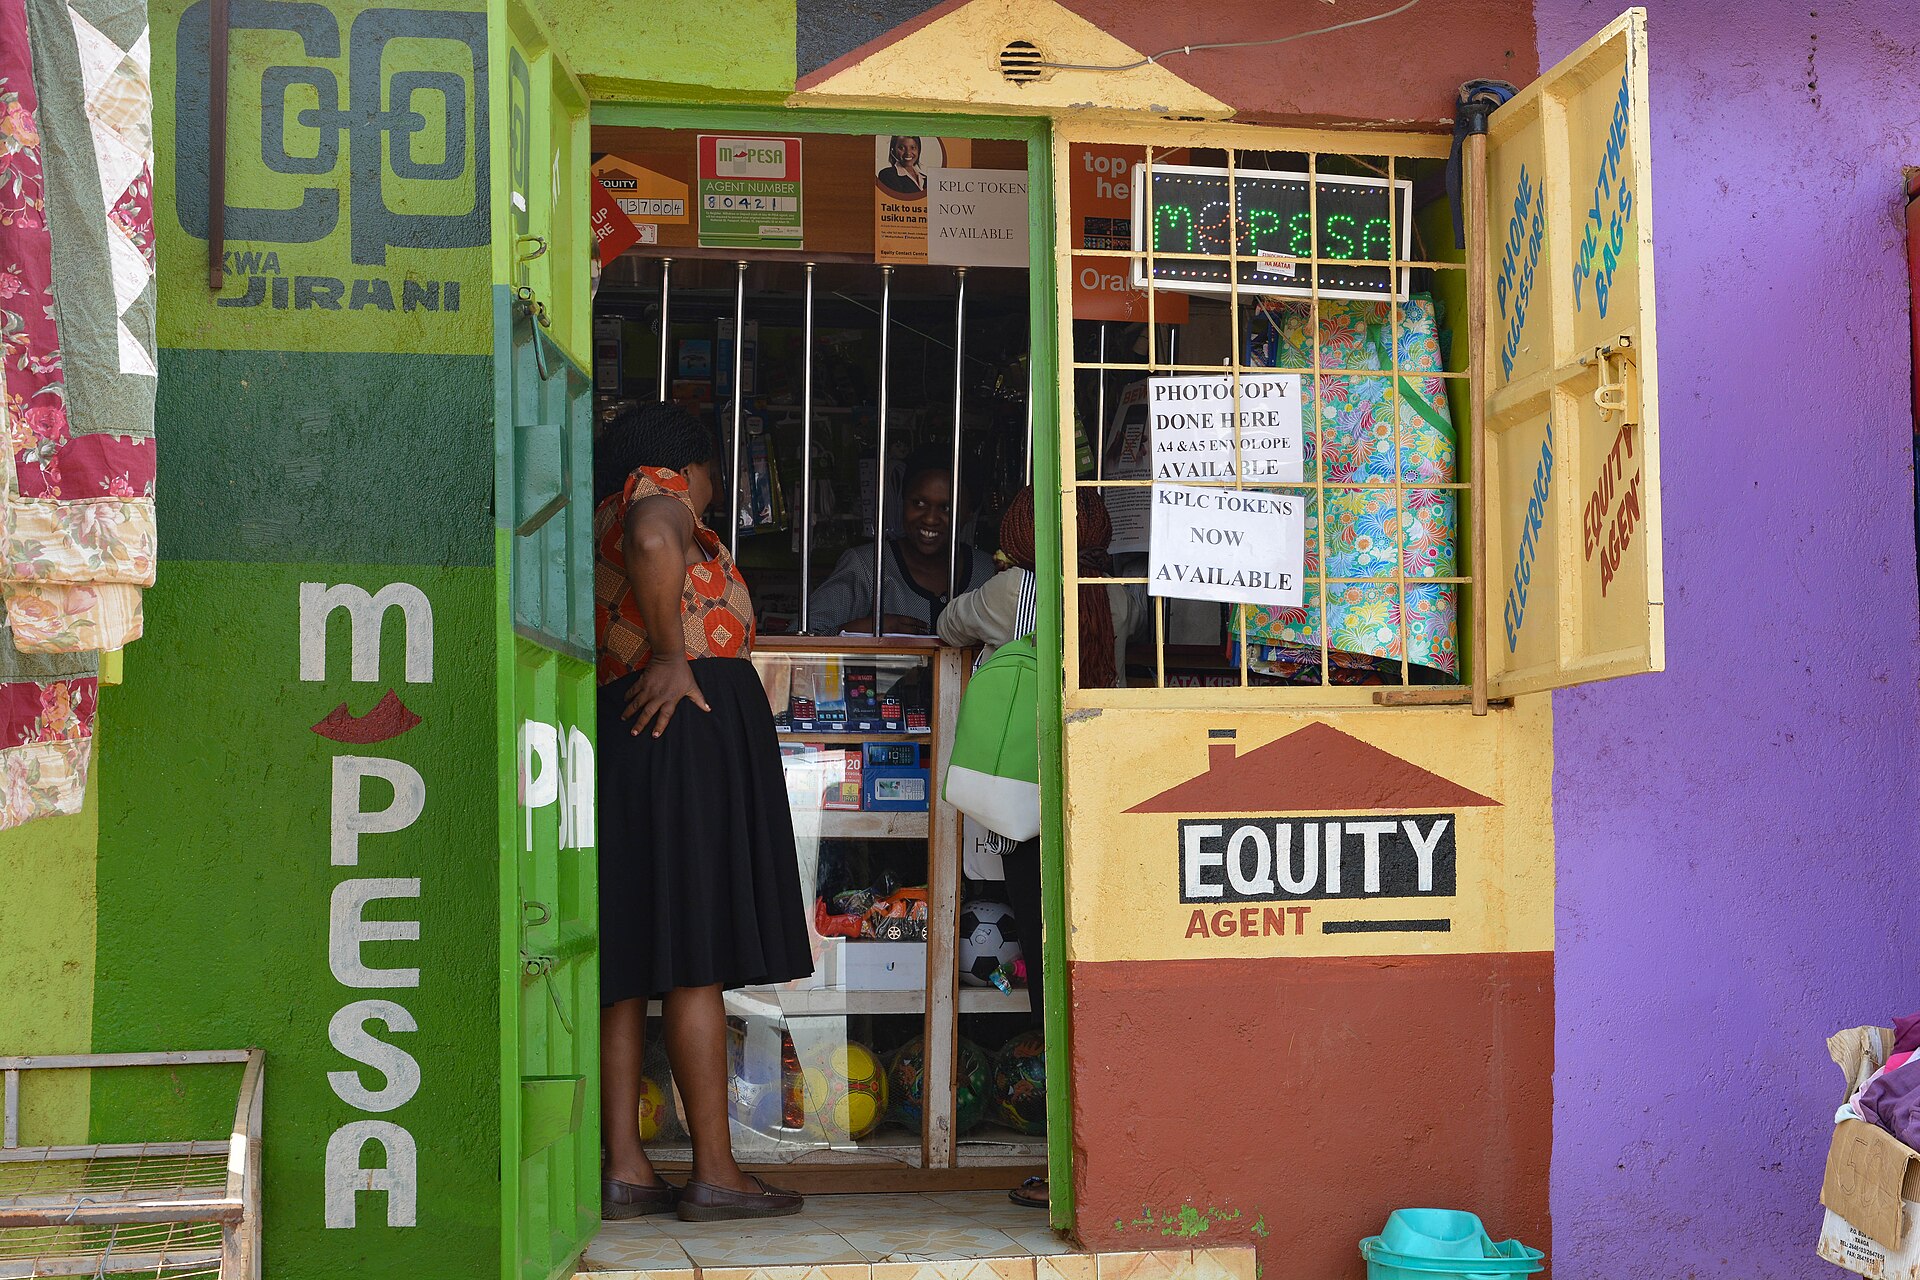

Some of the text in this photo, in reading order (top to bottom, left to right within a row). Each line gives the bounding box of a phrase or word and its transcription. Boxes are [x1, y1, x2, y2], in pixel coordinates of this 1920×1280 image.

[1083, 151, 1127, 178] top
[706, 182, 794, 193] AGENT NUMBER
[939, 181, 974, 192] KPLC
[1097, 177, 1129, 199] he
[1573, 56, 1630, 312] POLYTHEN
[708, 196, 775, 210] 80421
[881, 203, 900, 213] Talk
[902, 204, 910, 212] to
[939, 203, 976, 215] NOW
[591, 207, 608, 225] UP
[881, 213, 904, 222] usiku
[597, 222, 615, 242] RE
[939, 227, 1014, 240] AVAILABLE
[1497, 163, 1532, 321] PHONE
[1596, 176, 1632, 319] BAGS
[216, 276, 460, 313] JIRANI
[1155, 382, 1289, 401] PHOTOCOPY
[1156, 411, 1280, 430] DONE HERE
[1157, 441, 1173, 452] A4
[1210, 437, 1291, 451] ENVOLOPE
[1158, 459, 1279, 478] AVAILABLE
[1159, 490, 1293, 516] KPLC TOKENS
[1584, 425, 1633, 562] EQUITY
[1190, 527, 1244, 546] NOW
[1156, 564, 1293, 591] AVAILABLE
[1184, 819, 1450, 898] EQUITY
[1185, 906, 1312, 939] AGENT
